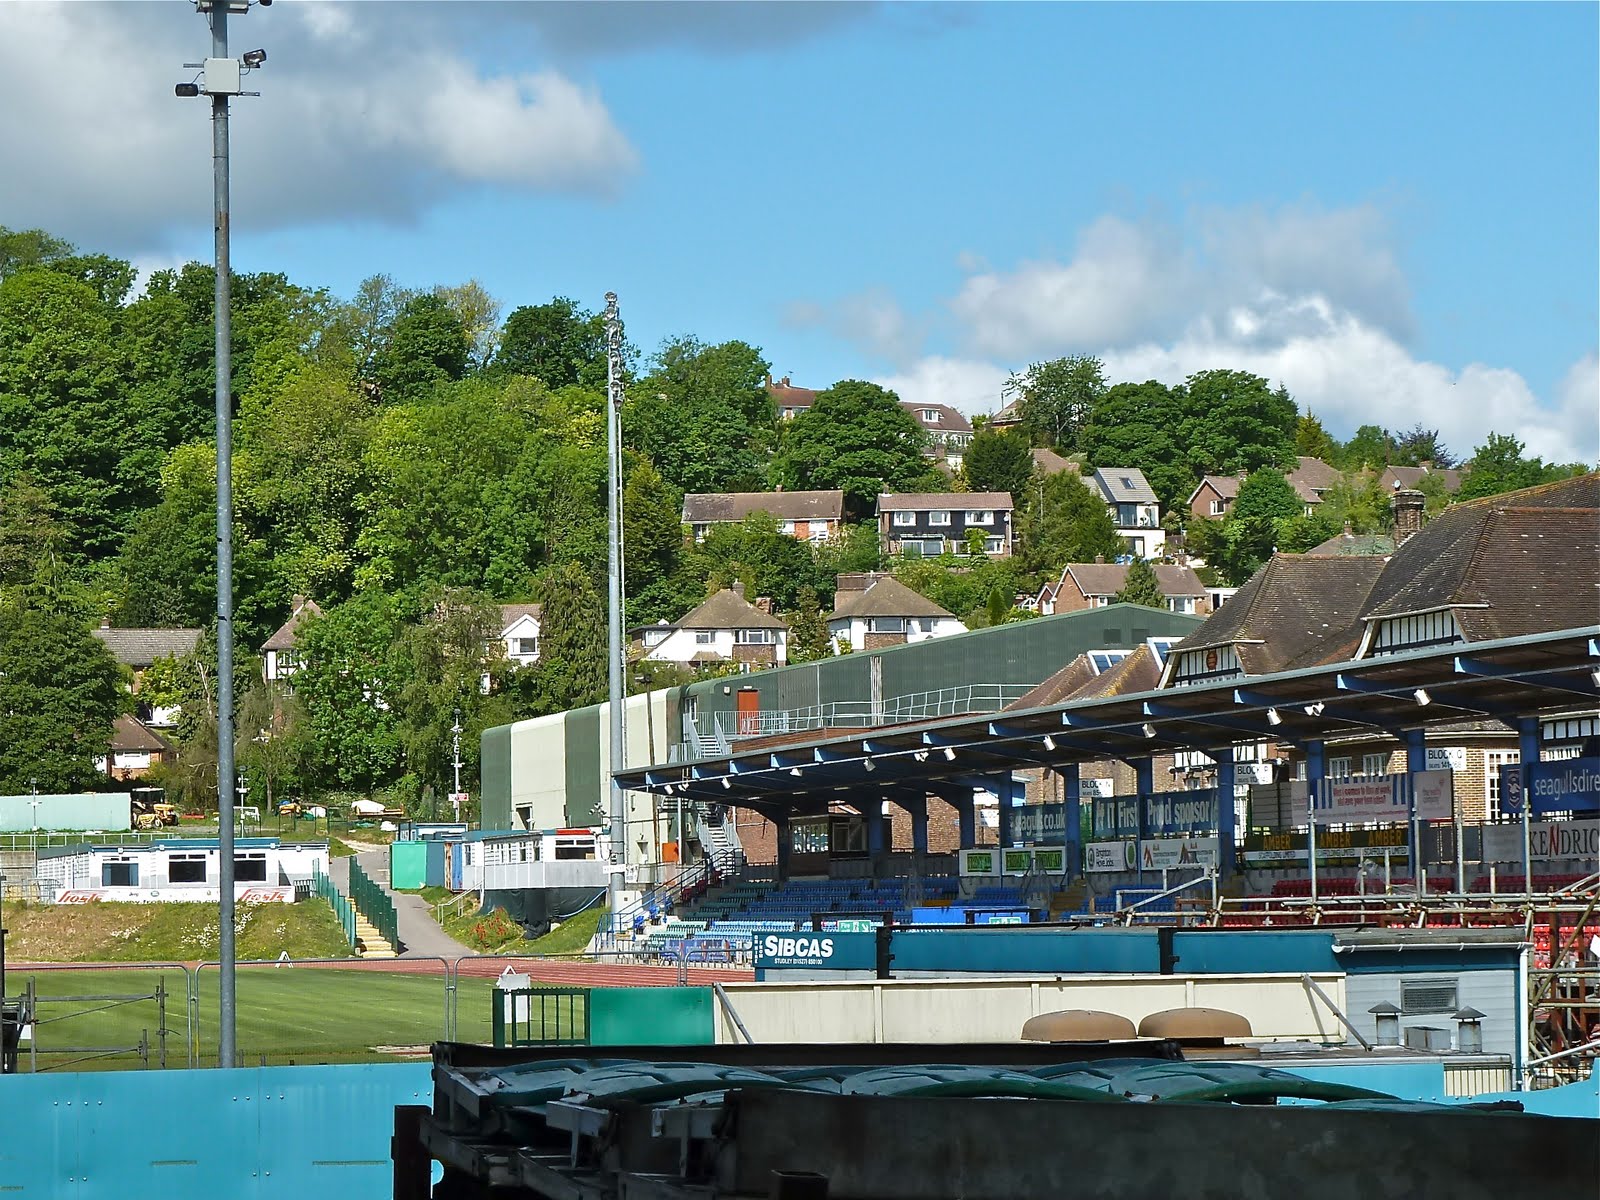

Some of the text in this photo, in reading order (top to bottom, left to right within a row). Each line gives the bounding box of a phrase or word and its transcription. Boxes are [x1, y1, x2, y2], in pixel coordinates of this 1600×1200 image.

[1237, 766, 1259, 775] BLOC
[1082, 781, 1102, 789] BLOC
[1534, 769, 1600, 801] seagullsdire
[1118, 801, 1138, 828] First
[1263, 835, 1291, 850] AMBER
[1320, 832, 1351, 848] AMBER
[1368, 830, 1402, 847] AMBER
[764, 935, 834, 958] SIBCAS
